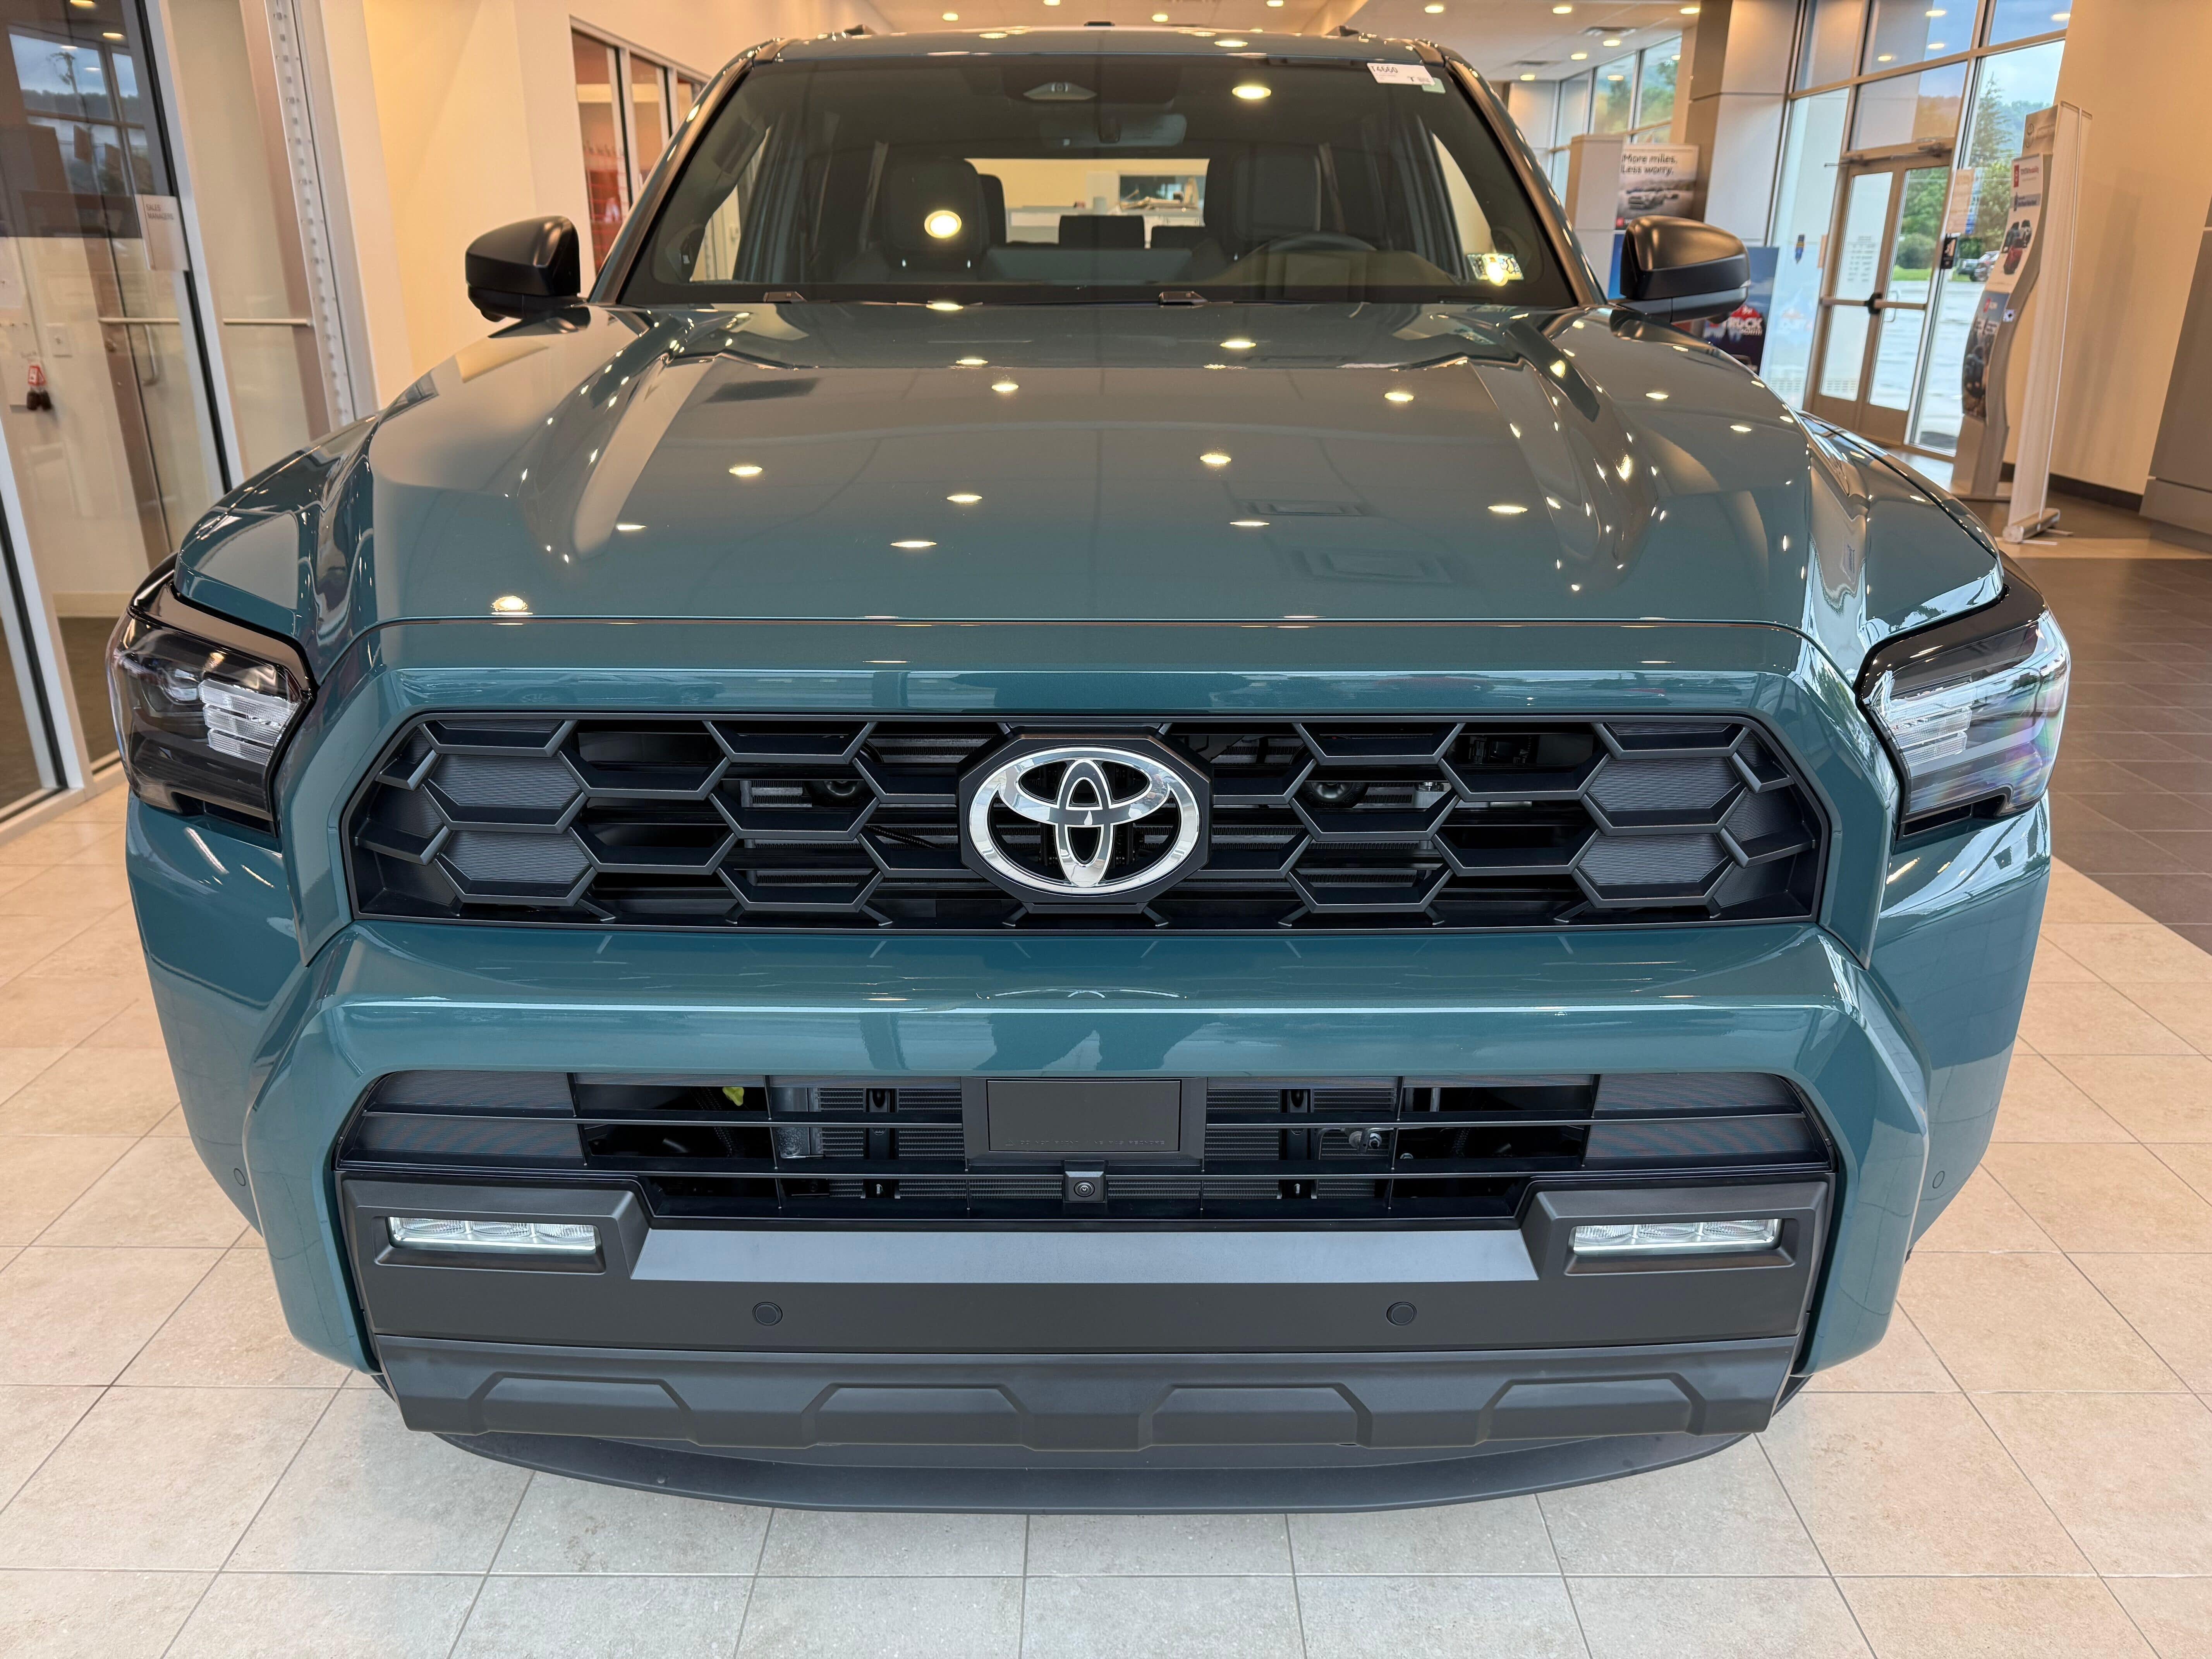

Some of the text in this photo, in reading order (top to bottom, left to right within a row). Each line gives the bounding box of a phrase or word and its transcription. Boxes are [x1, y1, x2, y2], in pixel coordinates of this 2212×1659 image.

[1622, 154, 1677, 163] More miles.
[1621, 165, 1673, 176] Less worry.
